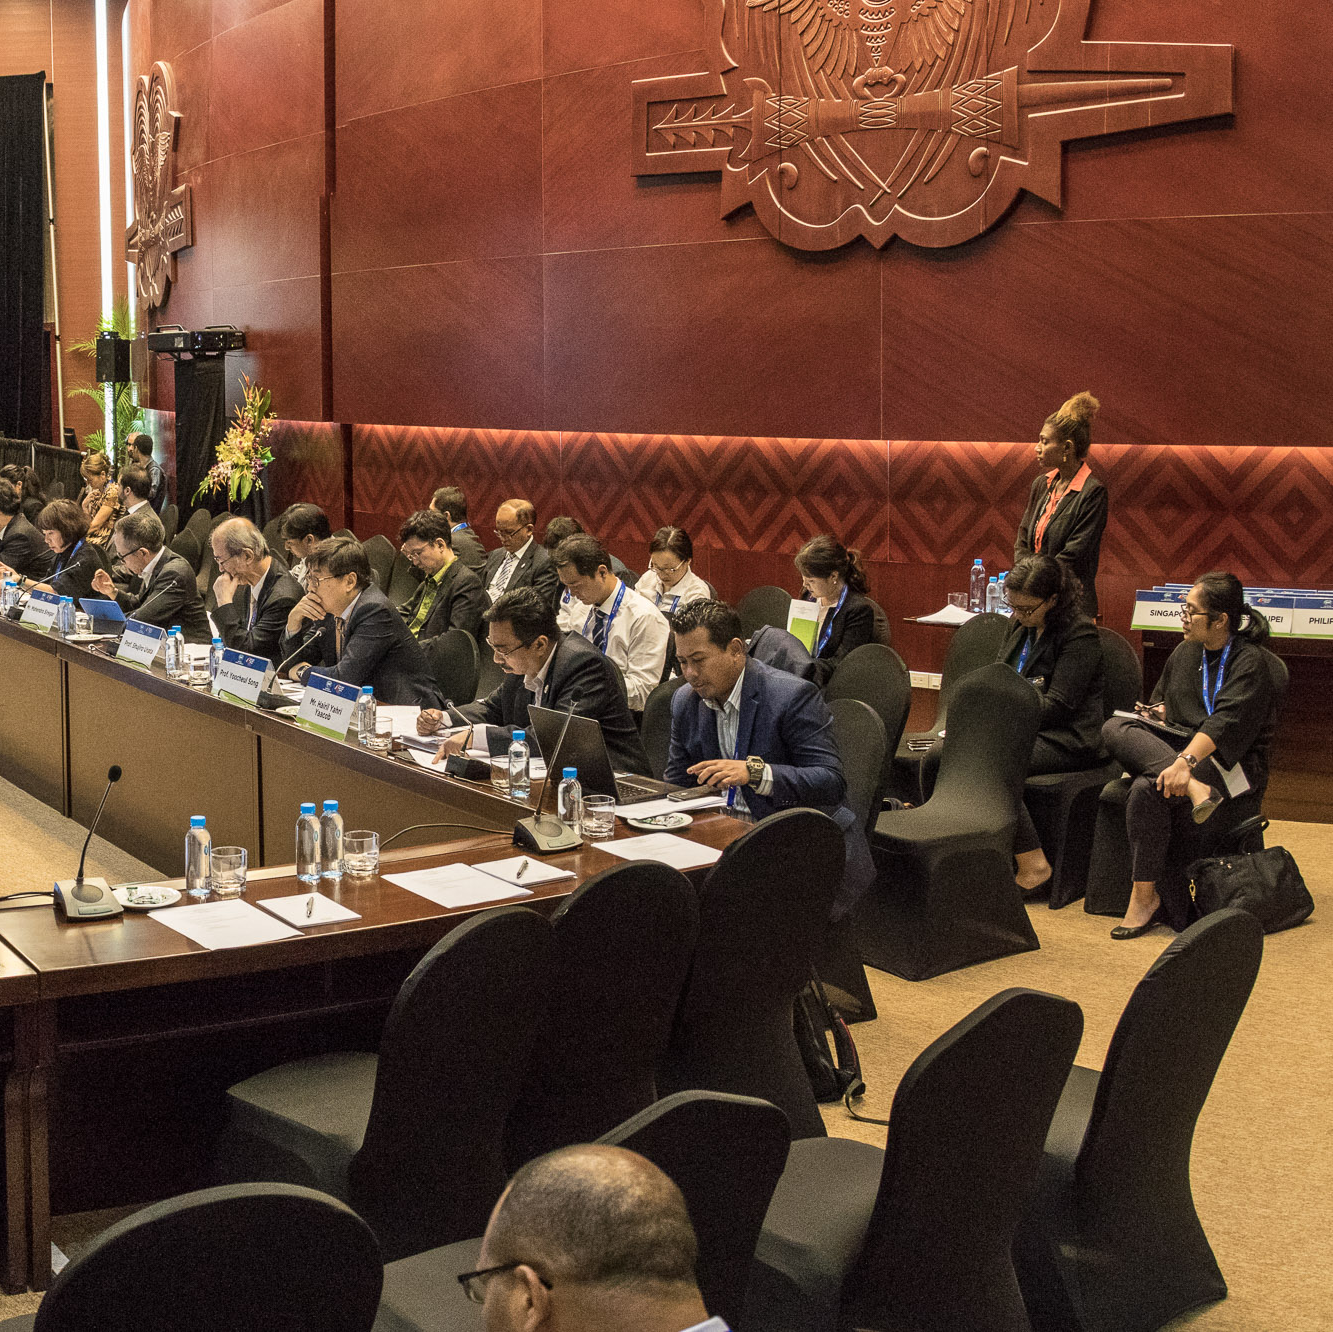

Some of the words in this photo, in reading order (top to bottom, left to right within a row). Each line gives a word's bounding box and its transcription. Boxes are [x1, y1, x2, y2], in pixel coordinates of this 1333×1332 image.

[219, 669, 229, 678] Prof.
[248, 678, 259, 689] Song
[309, 698, 318, 707] Mr.
[314, 708, 332, 721] Yaacob
